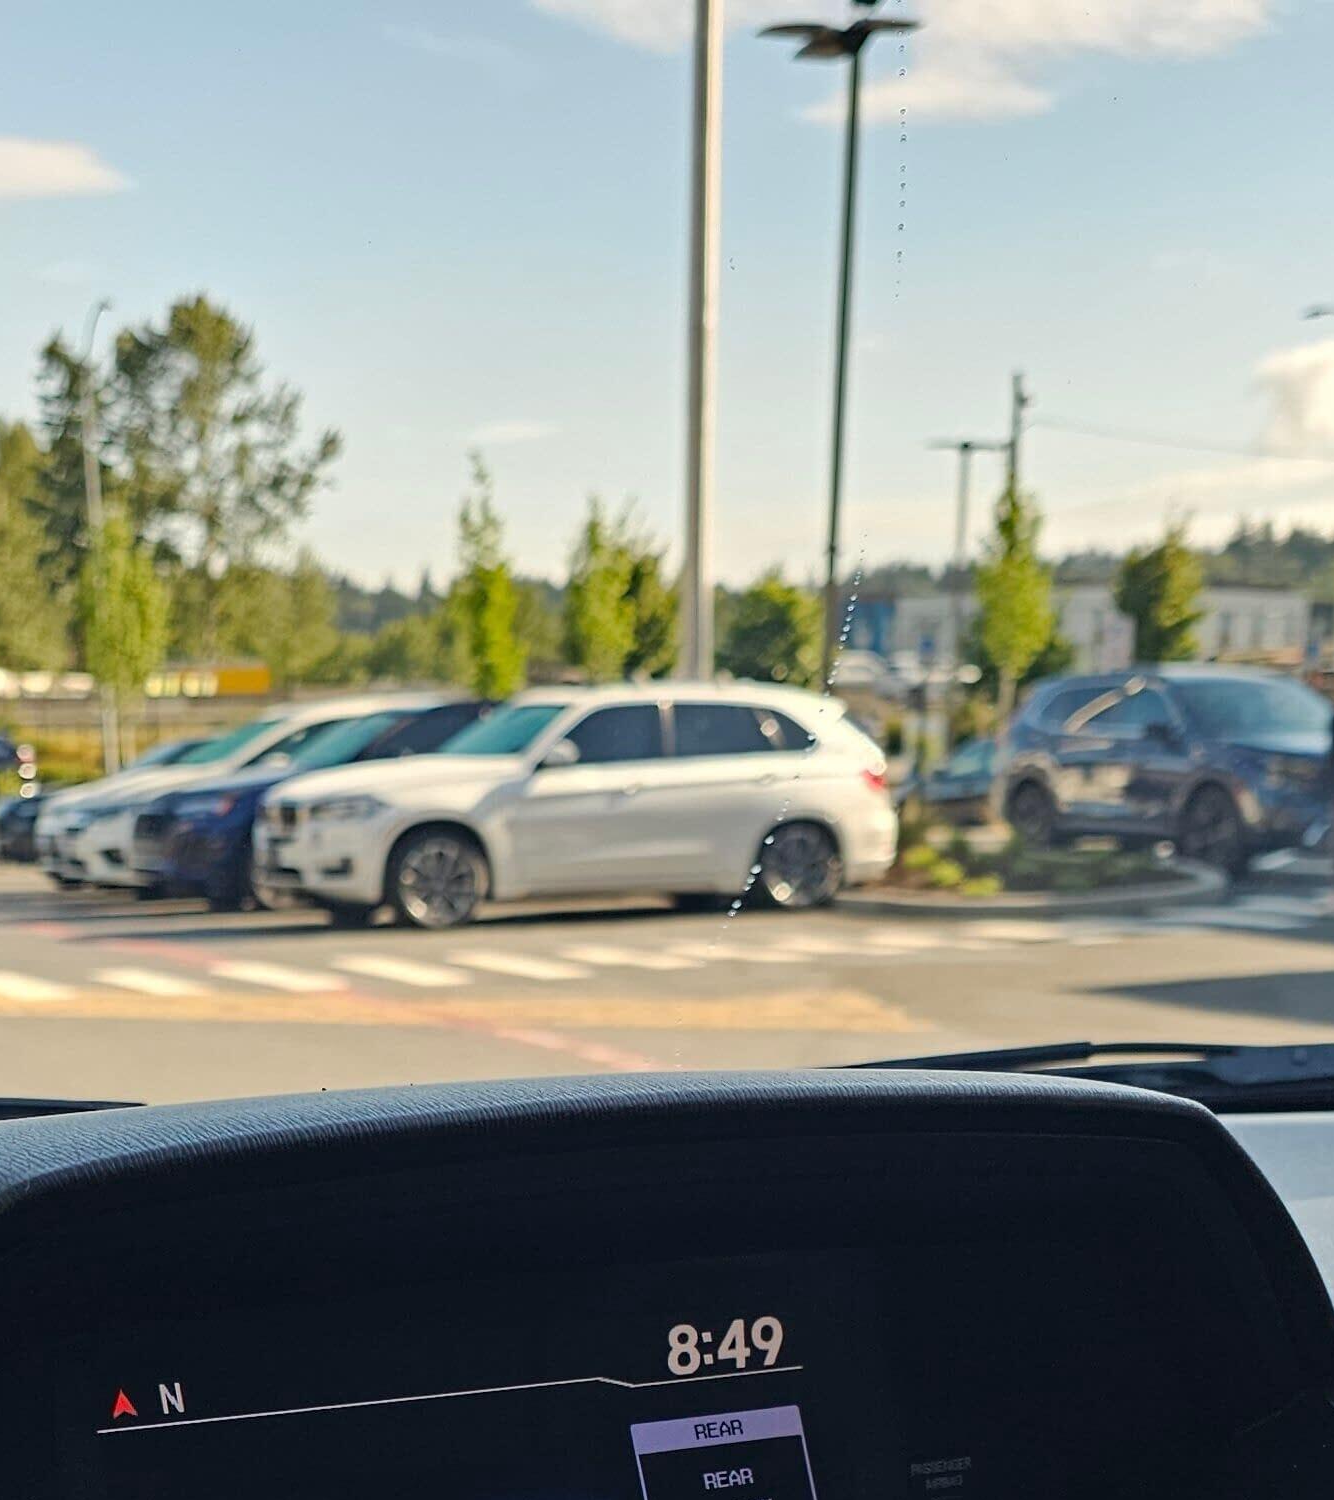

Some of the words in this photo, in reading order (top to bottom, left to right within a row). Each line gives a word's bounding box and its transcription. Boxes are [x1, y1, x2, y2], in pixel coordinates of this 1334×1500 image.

[667, 1316, 783, 1376] 8:49
[157, 1382, 185, 1415] N
[693, 1419, 744, 1441] REAR
[703, 1467, 754, 1490] REAR
